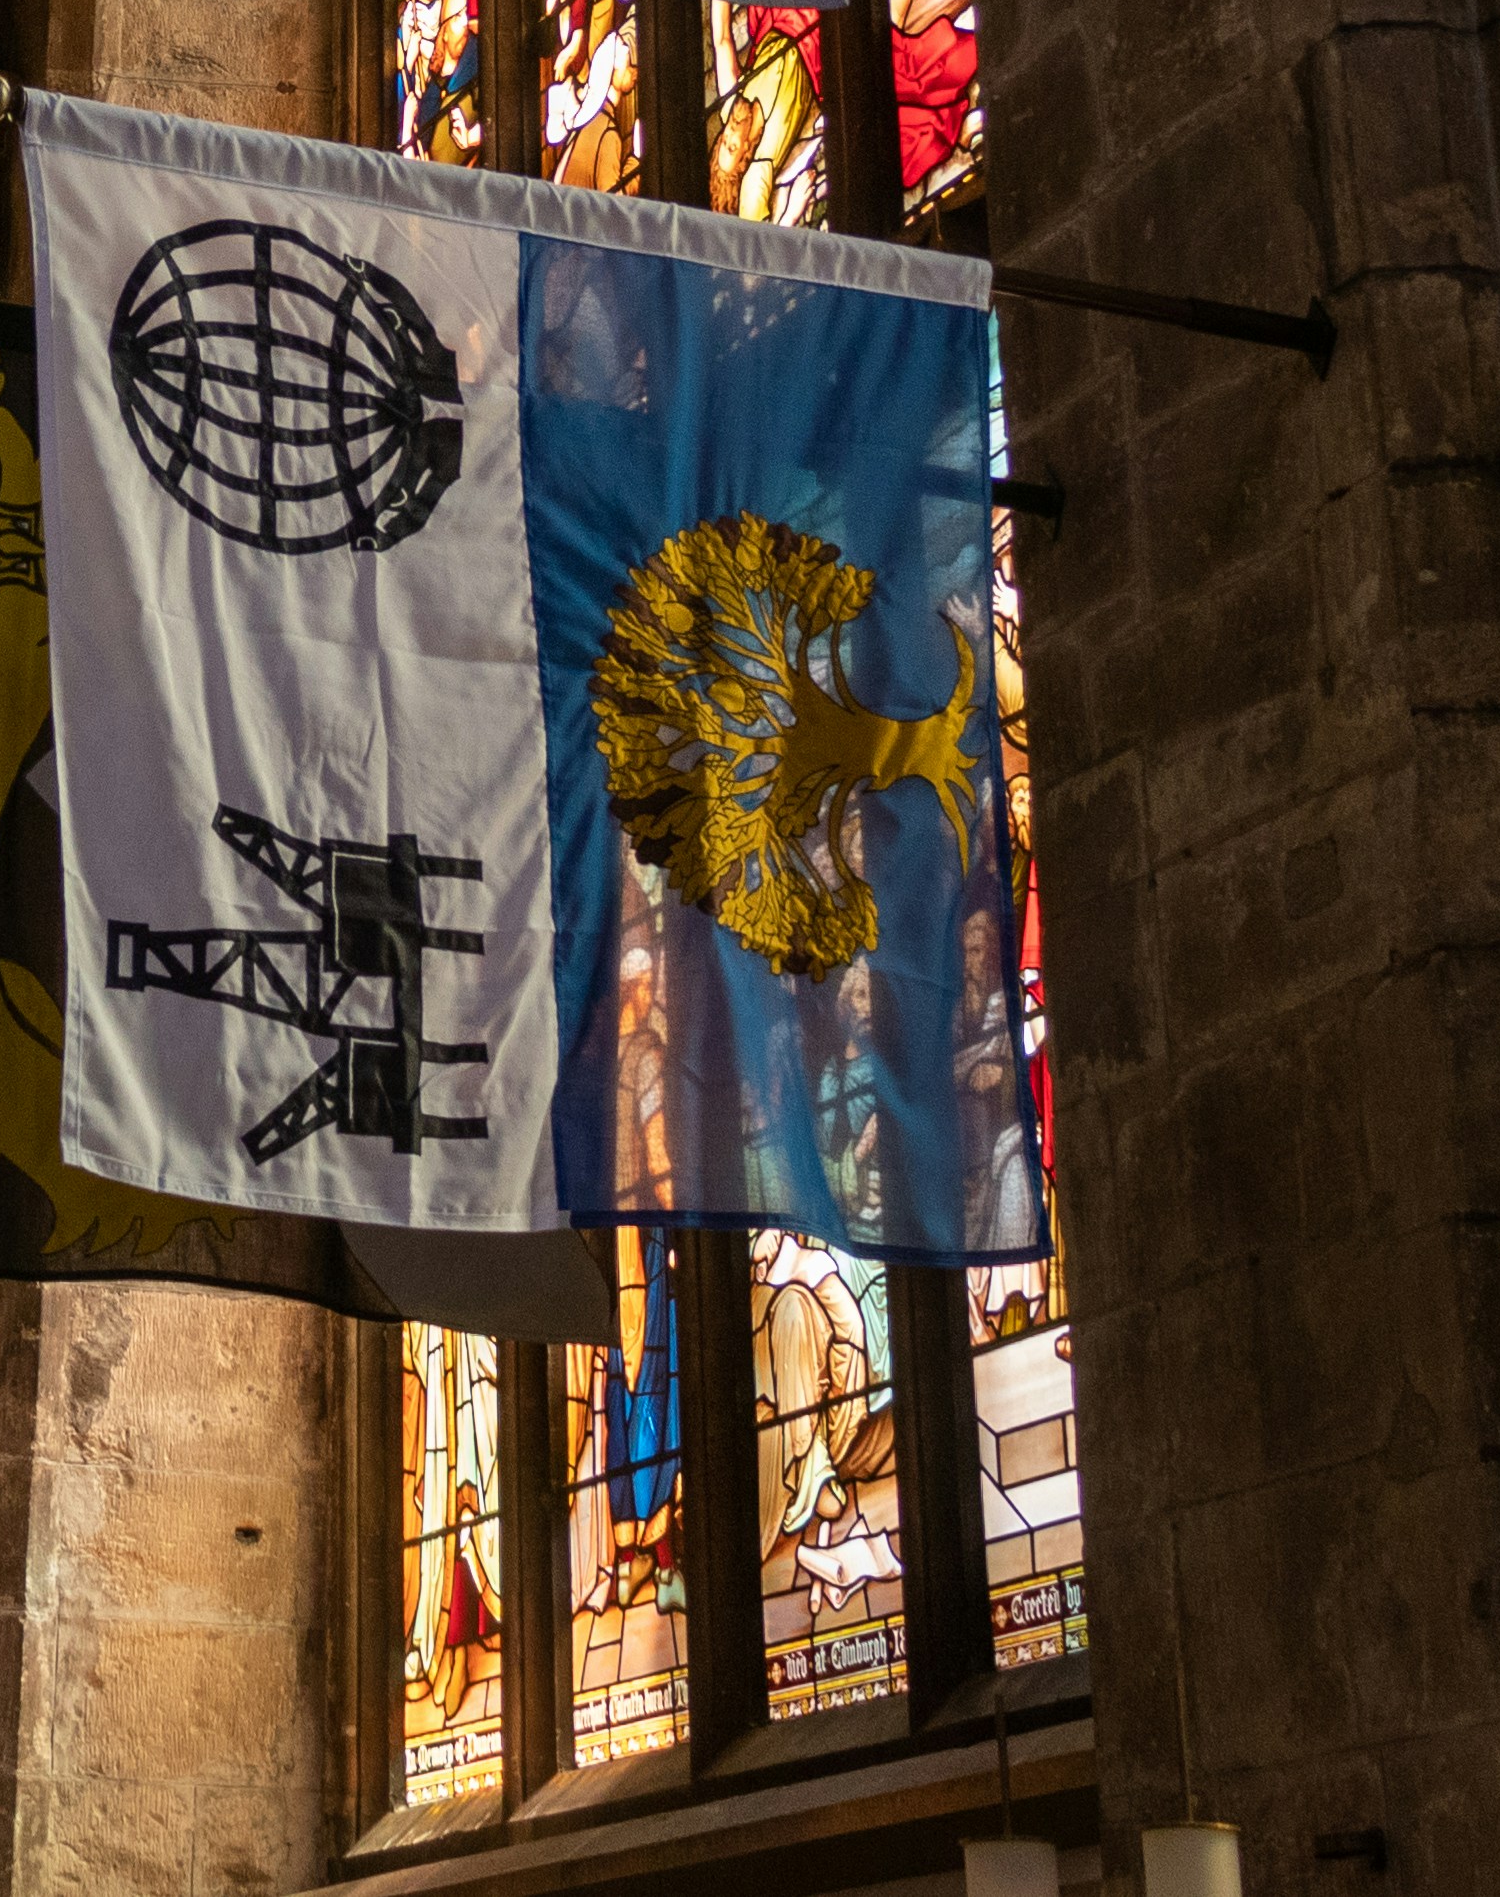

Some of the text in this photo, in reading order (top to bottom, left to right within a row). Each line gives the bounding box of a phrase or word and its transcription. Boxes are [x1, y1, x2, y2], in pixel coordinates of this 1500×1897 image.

[814, 1646, 827, 1674] at
[831, 1631, 887, 1670] Edinburgh
[1011, 1585, 1061, 1625] Erected
[1065, 1580, 1081, 1615] by
